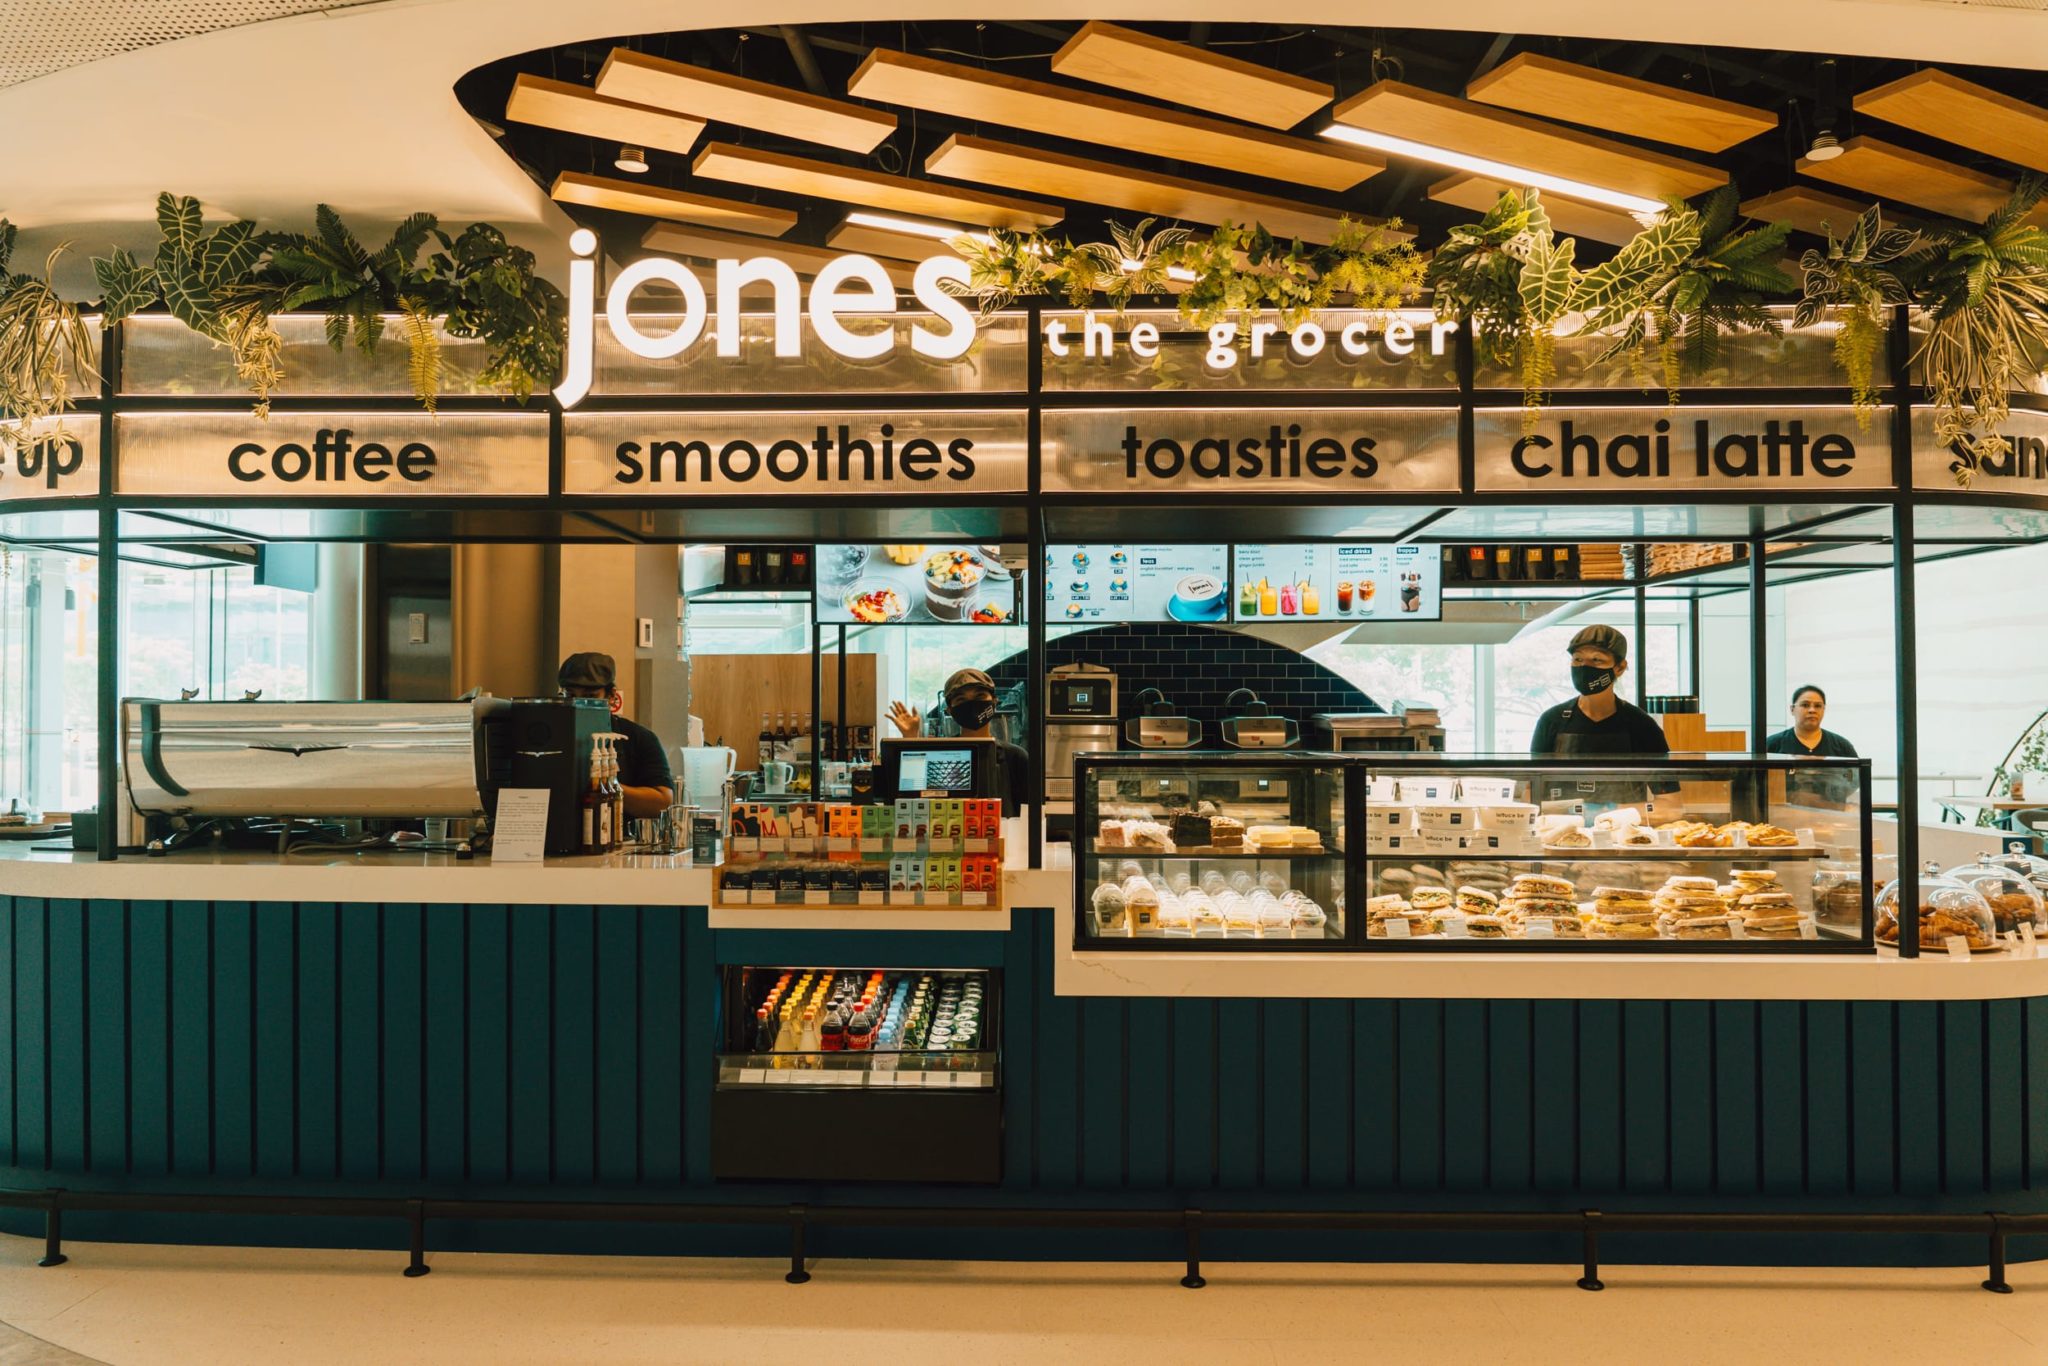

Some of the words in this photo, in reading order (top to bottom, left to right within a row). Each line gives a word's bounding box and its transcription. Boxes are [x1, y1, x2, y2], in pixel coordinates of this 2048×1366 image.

[553, 228, 977, 409] jones
[1044, 311, 1160, 358] the
[1205, 318, 1460, 369] grocer
[17, 433, 84, 489] up
[227, 428, 437, 482] coffee
[615, 423, 976, 484] smoothies
[1121, 423, 1379, 479] toasties
[1510, 419, 1670, 479] chai
[1695, 419, 1857, 478] latte
[1949, 432, 2048, 479] san
